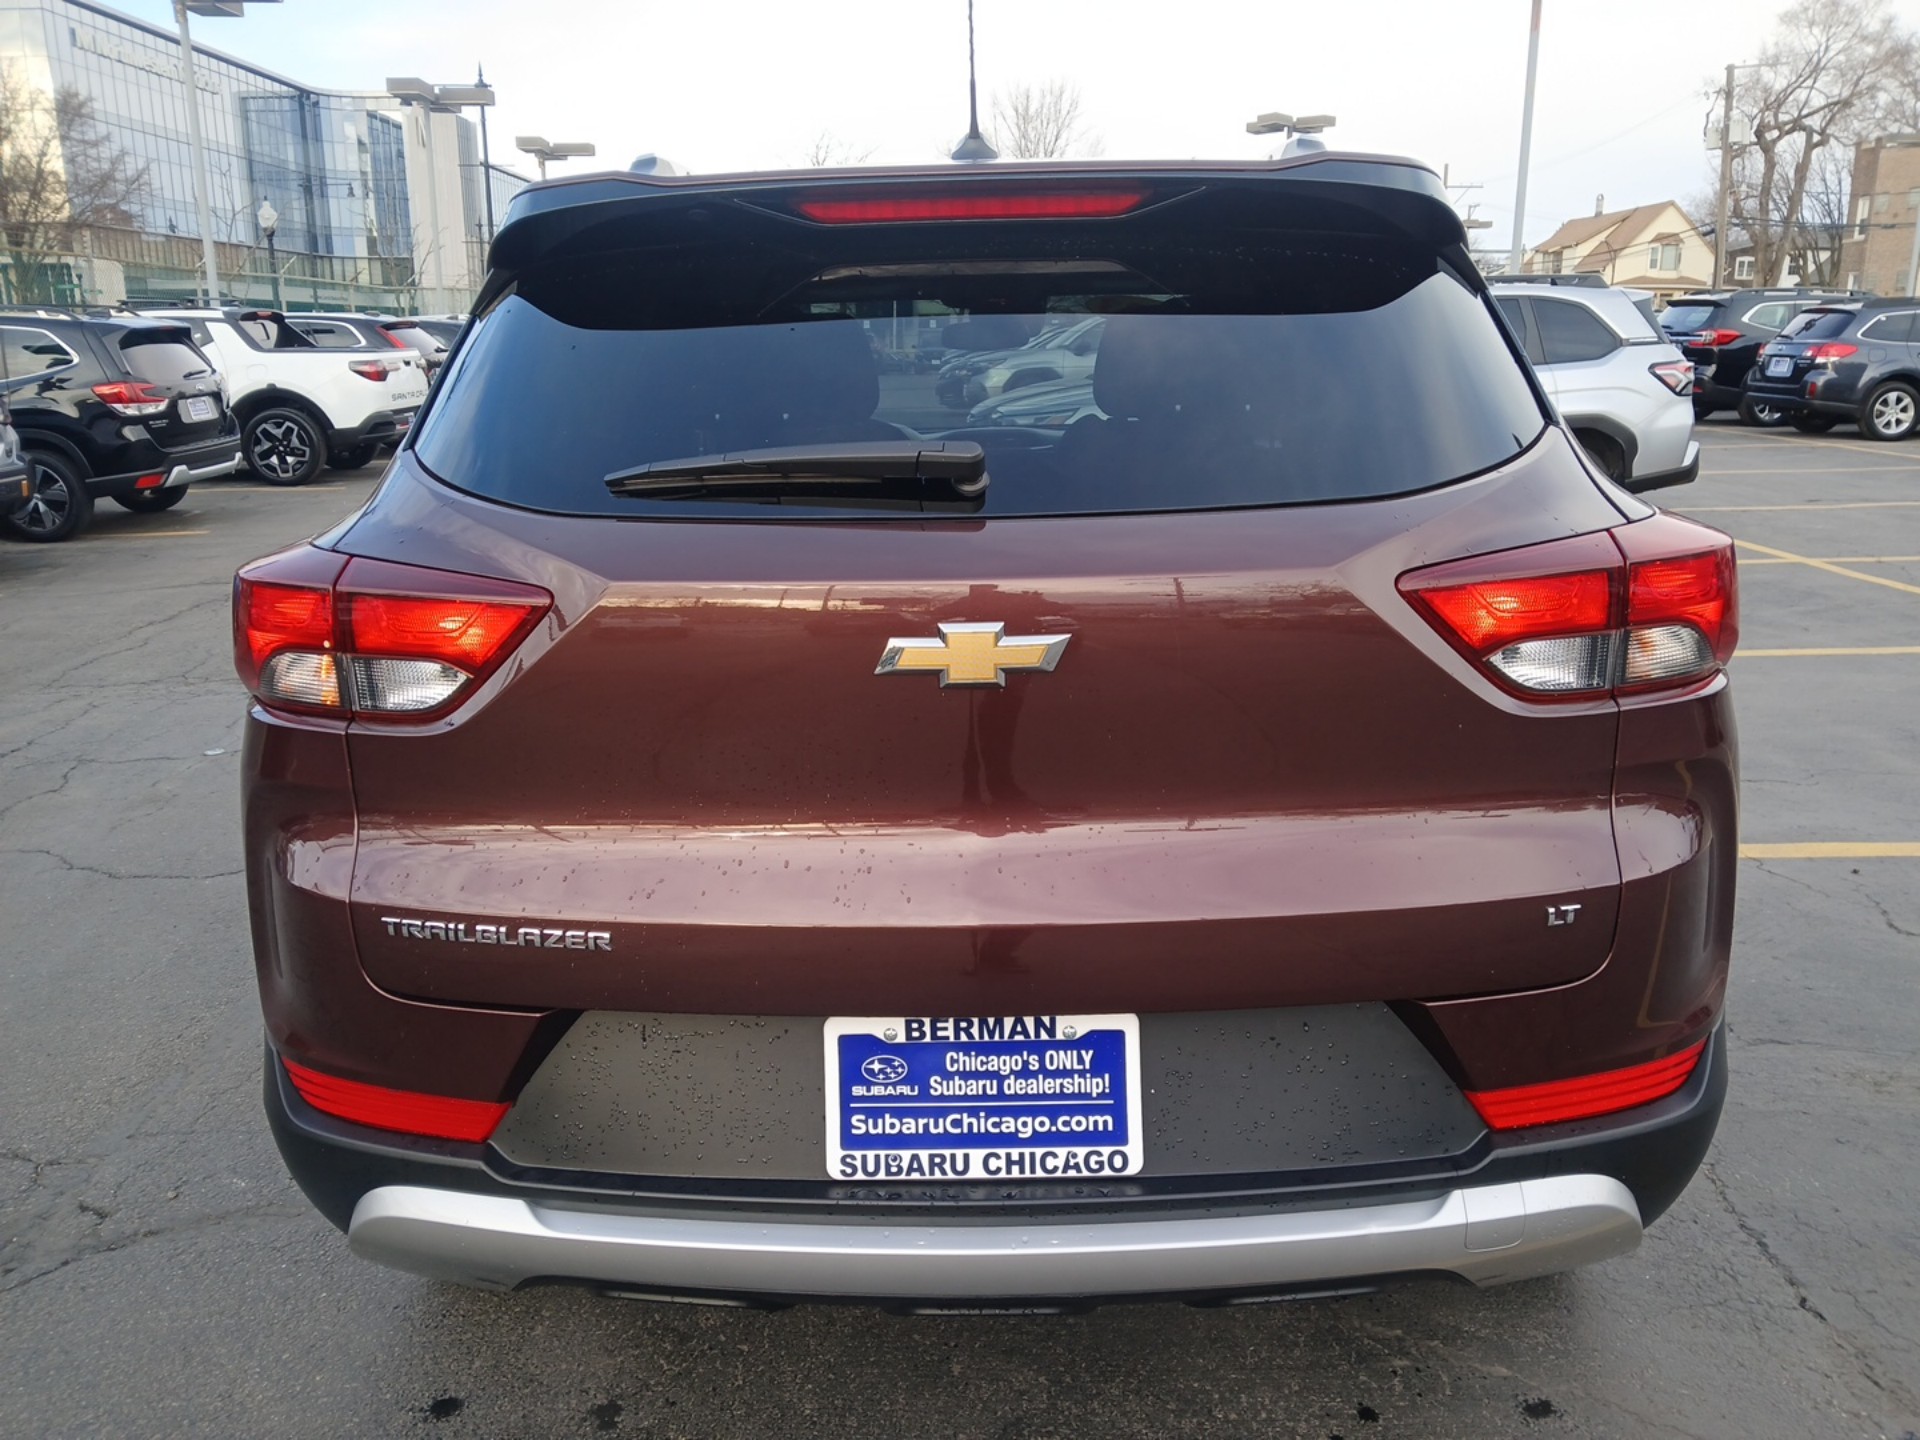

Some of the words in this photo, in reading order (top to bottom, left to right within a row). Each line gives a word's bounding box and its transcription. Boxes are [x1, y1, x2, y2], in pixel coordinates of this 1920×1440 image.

[1546, 904, 1582, 927] LT
[380, 916, 612, 951] TRAILBLAZER
[904, 1016, 1057, 1042] BERMAN
[945, 1051, 1039, 1075] Chicago's
[1045, 1050, 1094, 1071] ONLY
[851, 1085, 919, 1096] SUBARU
[929, 1075, 998, 1096] Subaru
[1003, 1073, 1111, 1098] dealership!
[850, 1111, 1114, 1138] SubaruChicago.com
[839, 1152, 971, 1178] SUBARU
[982, 1149, 1130, 1176] CHICAGO
